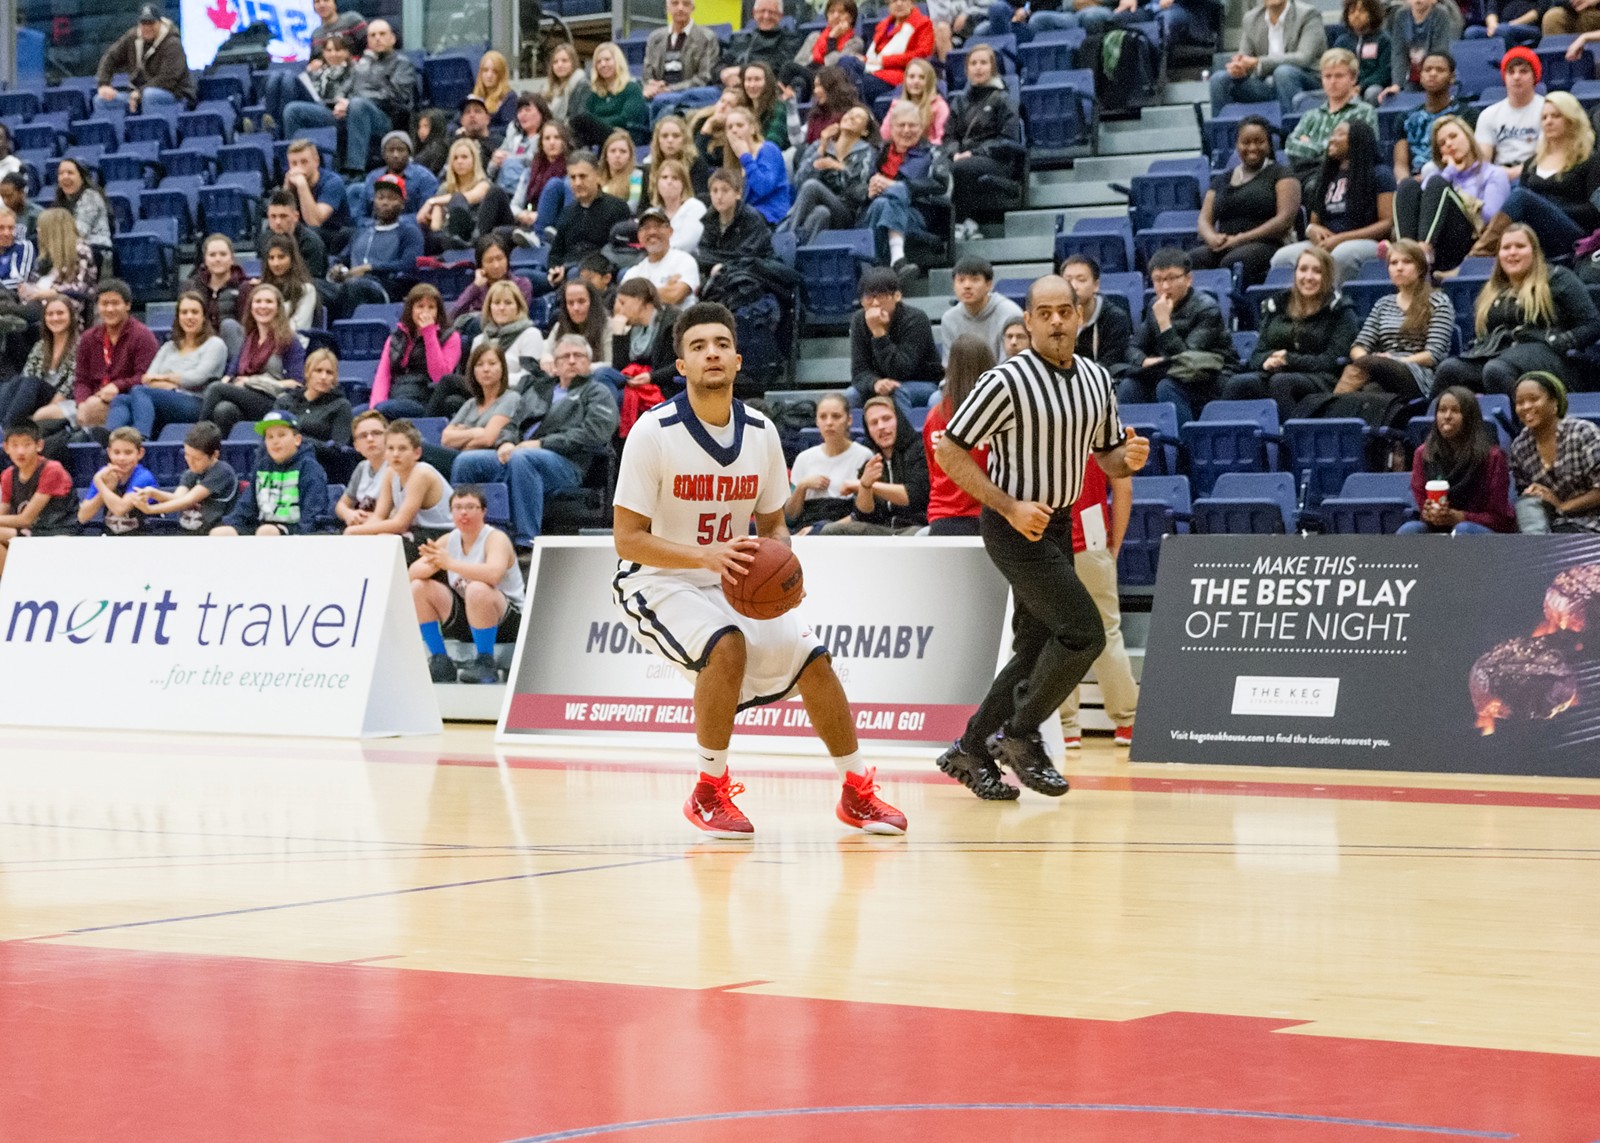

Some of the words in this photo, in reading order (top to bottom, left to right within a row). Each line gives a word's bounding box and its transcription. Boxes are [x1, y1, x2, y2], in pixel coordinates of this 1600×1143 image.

[673, 474, 714, 501] SIMON
[716, 474, 758, 502] FRASER
[697, 512, 733, 545] 50
[1252, 556, 1310, 575] MAKE
[1313, 556, 1356, 575] THIS
[1190, 578, 1250, 605] THE
[1256, 578, 1331, 606] BEST
[1336, 579, 1417, 606] PLAY
[5, 584, 177, 644] merit
[197, 578, 369, 648] travel
[1185, 611, 1232, 639] OF
[1238, 611, 1298, 639] THE
[1305, 612, 1410, 641] NIGHT.
[815, 624, 934, 659] URNABY
[201, 665, 234, 687] the
[239, 667, 350, 692] experience
[1251, 687, 1281, 699] THE
[1289, 688, 1321, 699] KEG
[565, 702, 588, 721] WE
[589, 703, 654, 723] SUPPORT
[734, 707, 782, 727] WEATY
[783, 708, 812, 728] LIVE
[856, 710, 895, 730] CLAN
[898, 711, 925, 731] GO!
[1170, 730, 1188, 740] Visit
[1189, 731, 1264, 744] kegsteakhouse.com
[1265, 734, 1275, 743] to
[1276, 733, 1292, 743] find
[1293, 734, 1307, 744] the
[1308, 734, 1340, 745] location
[1341, 737, 1372, 746] nearest
[1372, 738, 1391, 749] you.
